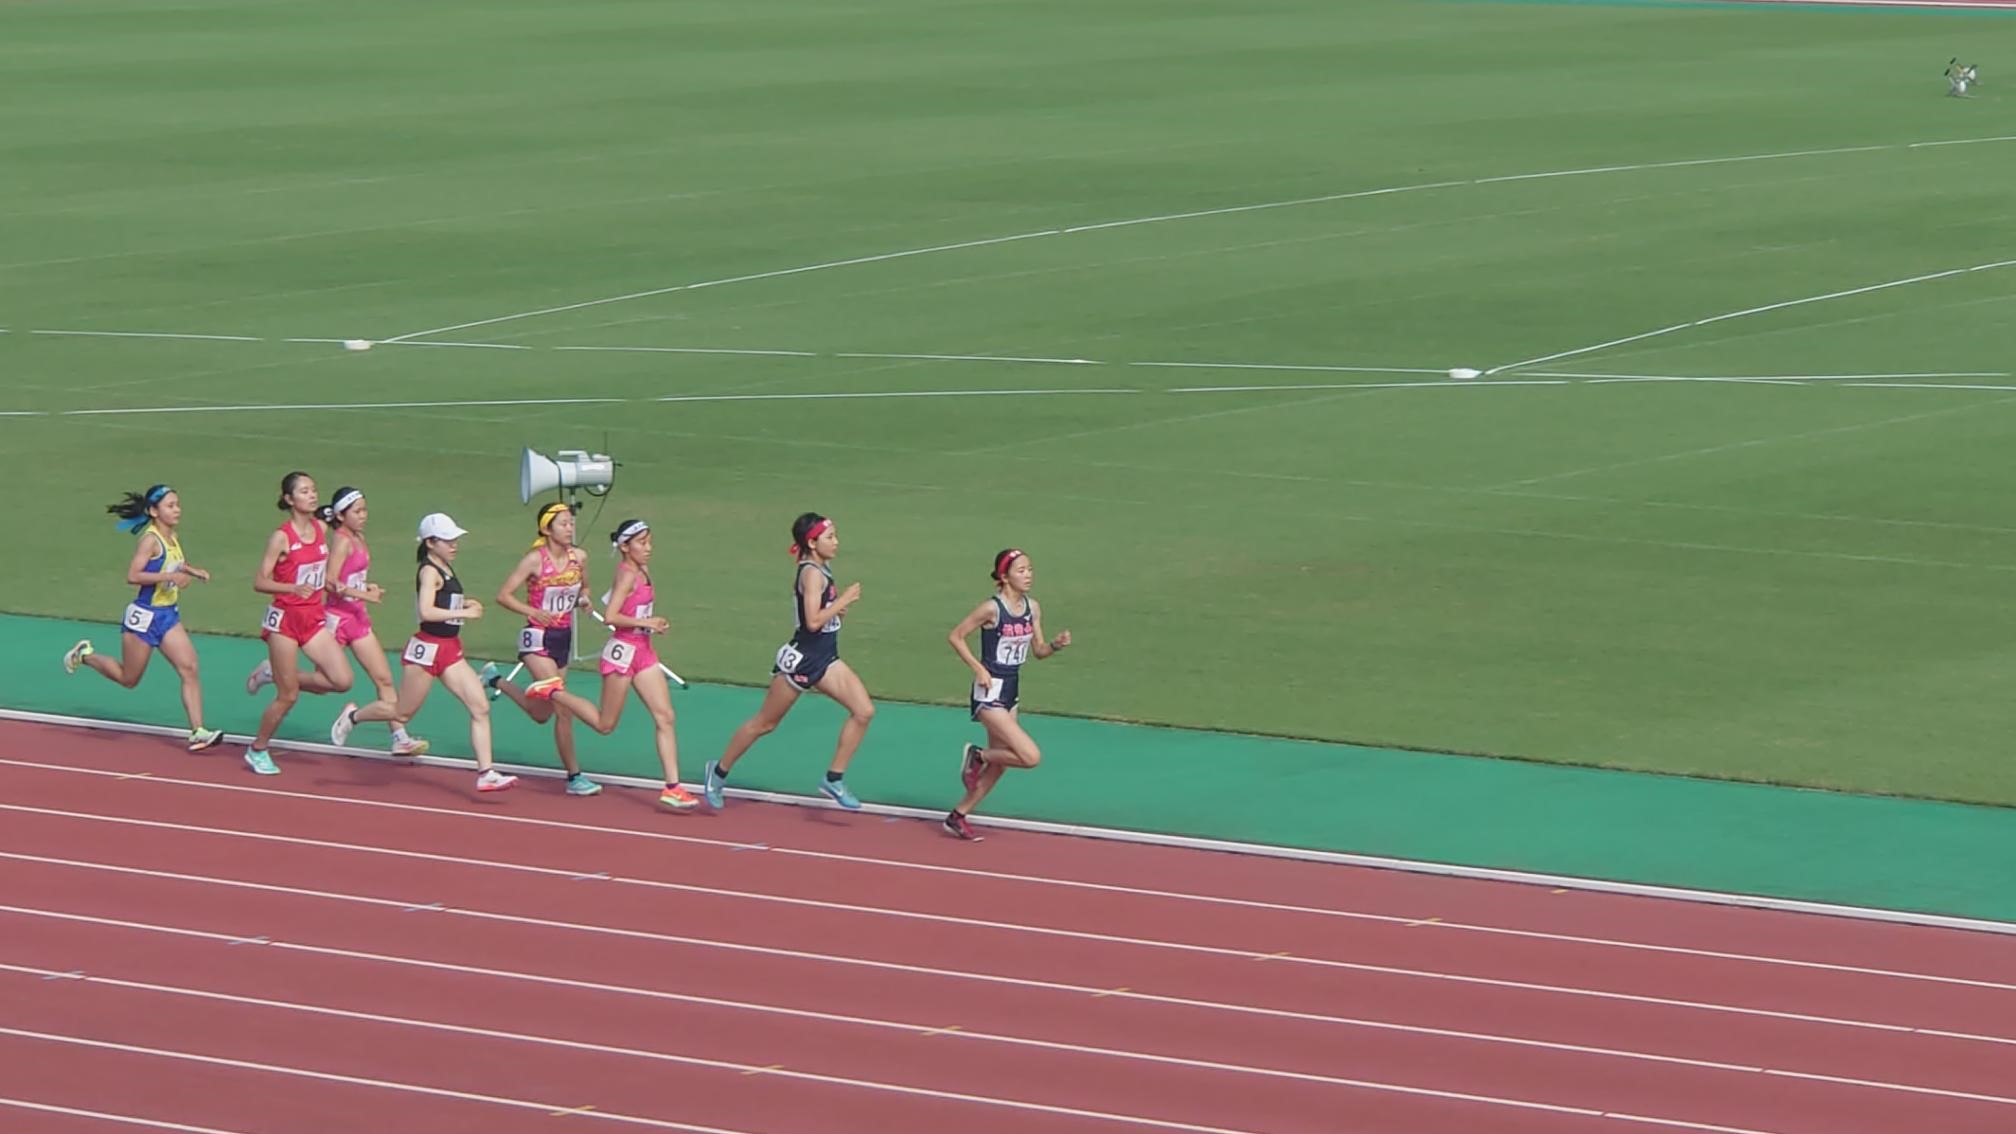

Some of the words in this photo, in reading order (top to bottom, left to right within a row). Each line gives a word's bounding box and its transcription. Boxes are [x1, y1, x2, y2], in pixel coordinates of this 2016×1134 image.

[129, 610, 142, 626] 5
[523, 631, 532, 648] 8
[415, 644, 426, 660] 9
[611, 644, 625, 660] 6
[779, 649, 797, 670] 13
